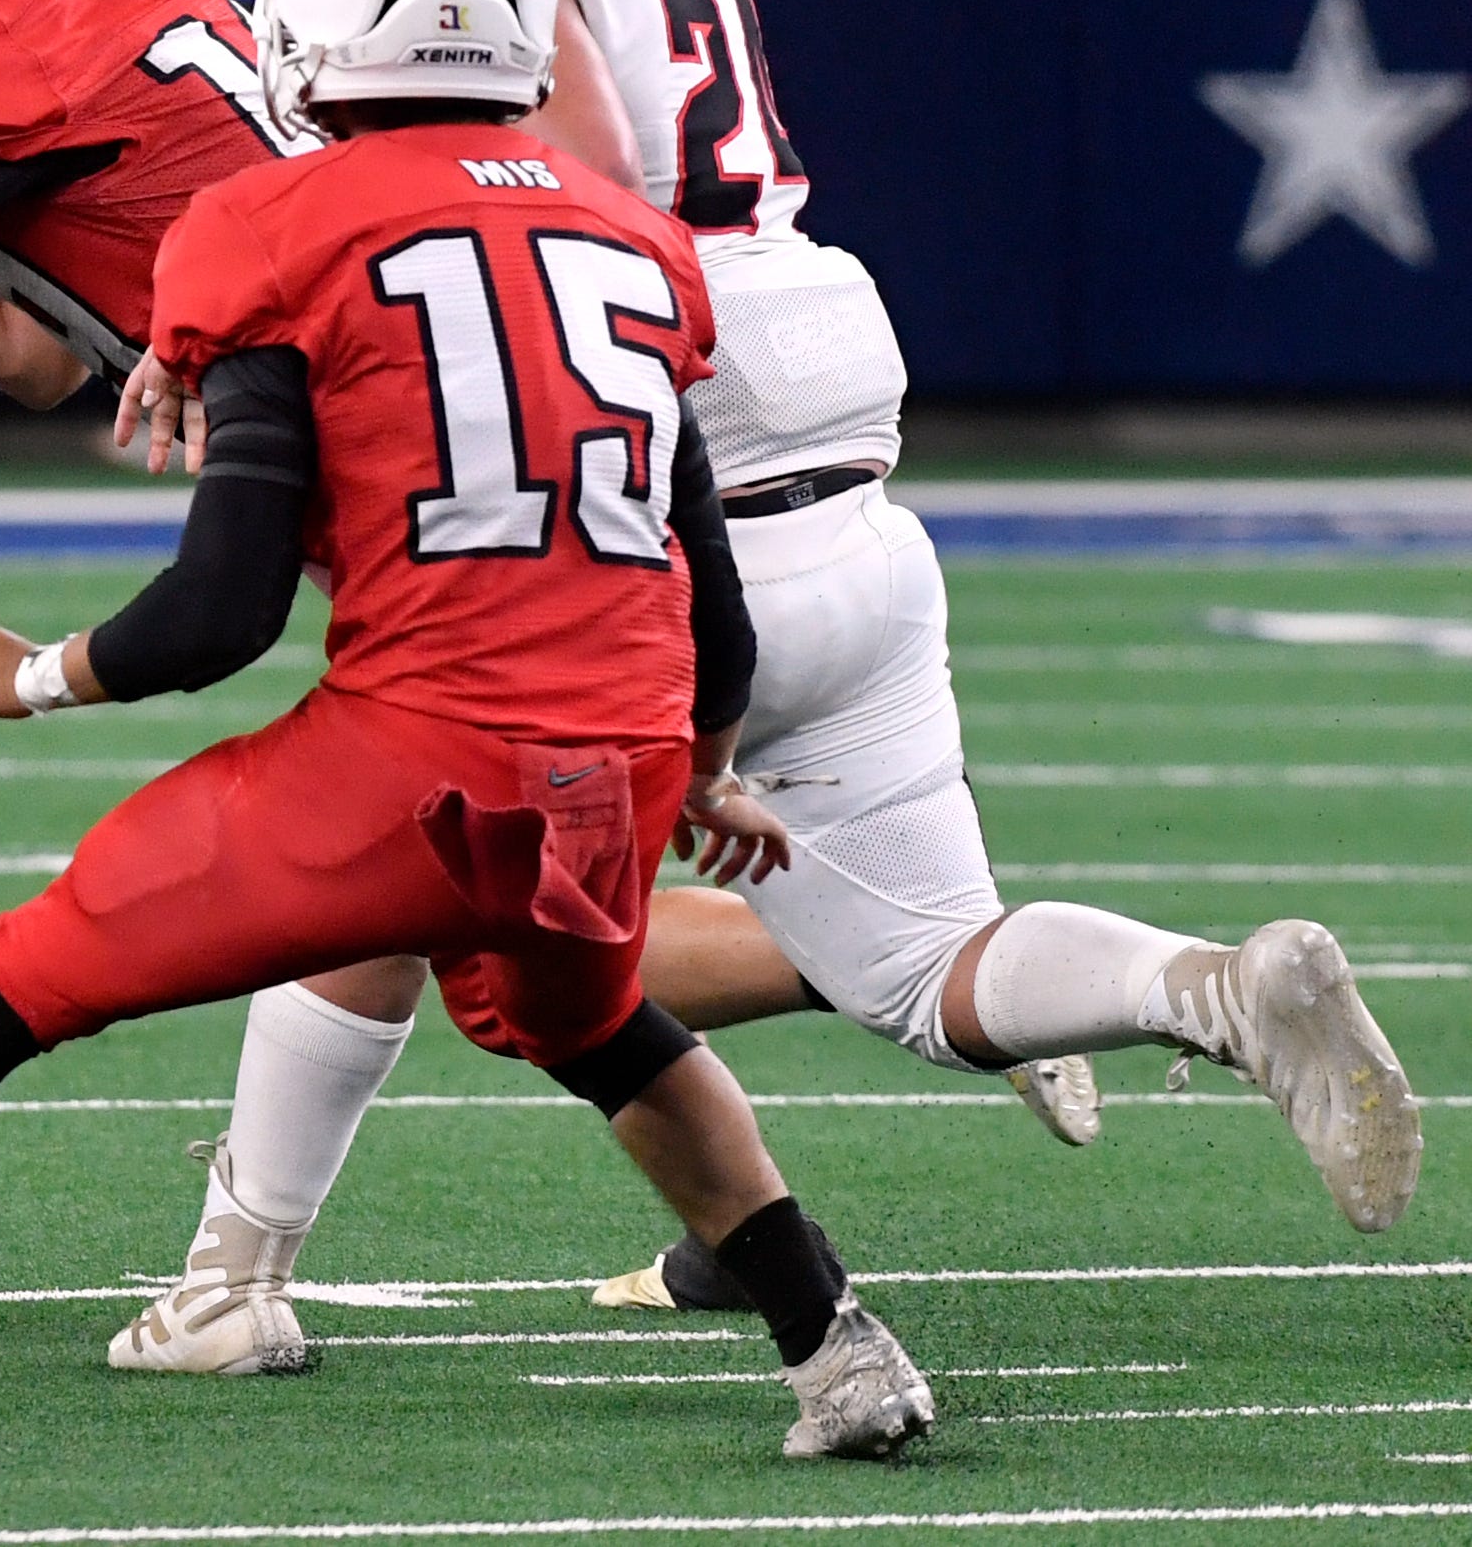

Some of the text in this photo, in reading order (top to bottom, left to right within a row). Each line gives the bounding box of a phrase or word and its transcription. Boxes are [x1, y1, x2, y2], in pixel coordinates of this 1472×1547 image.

[412, 48, 493, 64] XENITH
[457, 158, 562, 190] MIS
[366, 226, 681, 571] 15
